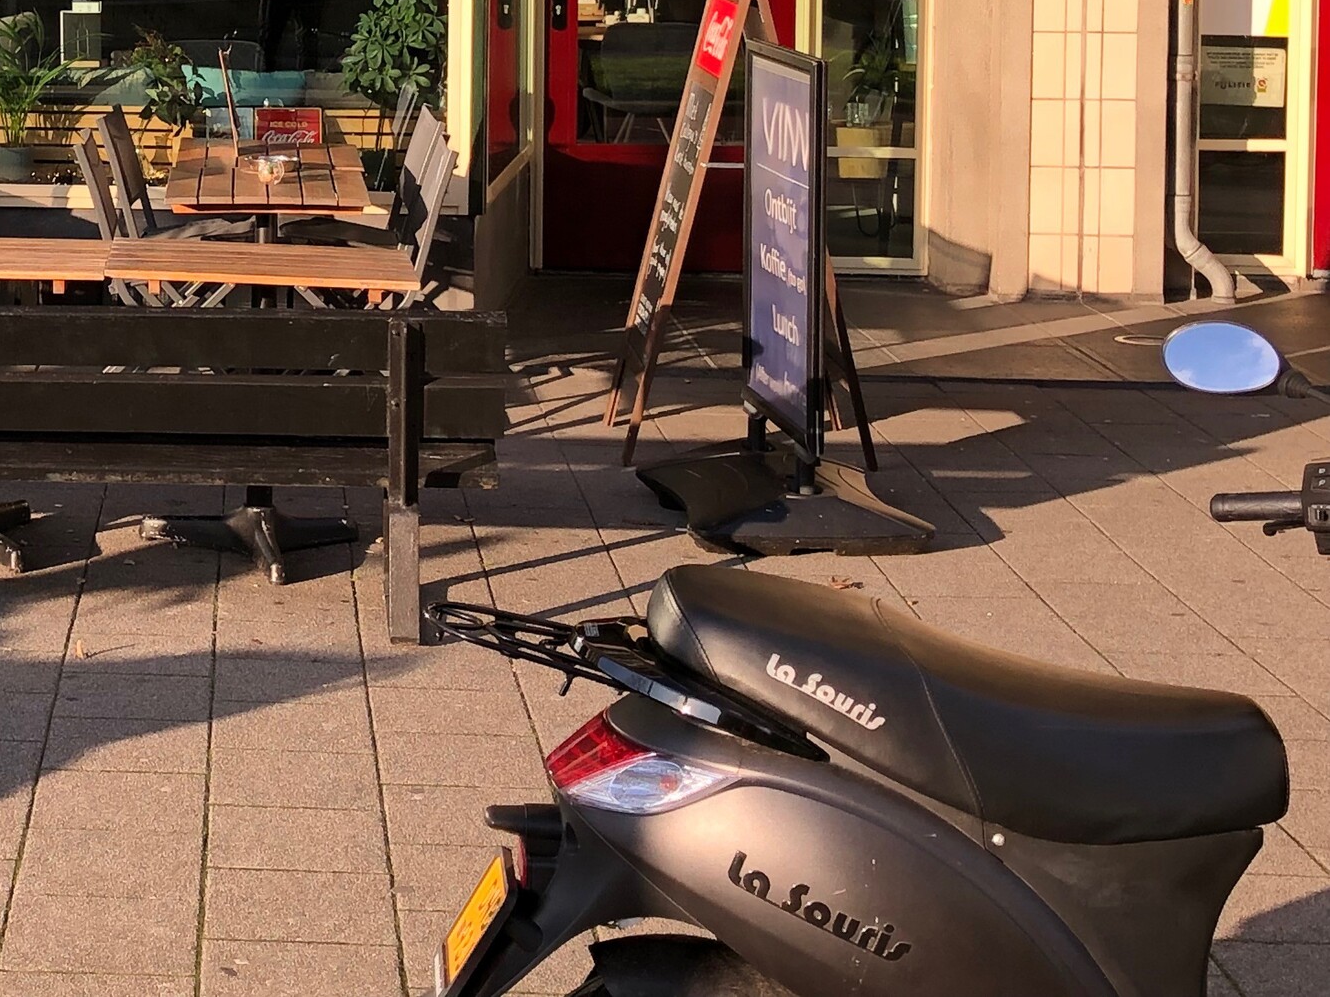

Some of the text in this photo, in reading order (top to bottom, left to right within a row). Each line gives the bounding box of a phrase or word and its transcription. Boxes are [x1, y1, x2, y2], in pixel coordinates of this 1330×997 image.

[762, 97, 810, 172] VINN
[764, 188, 797, 235] Ontbijt
[759, 242, 787, 282] Koffie
[771, 303, 800, 347] Lunch
[802, 672, 886, 731] Souris
[781, 883, 912, 962] Souris
